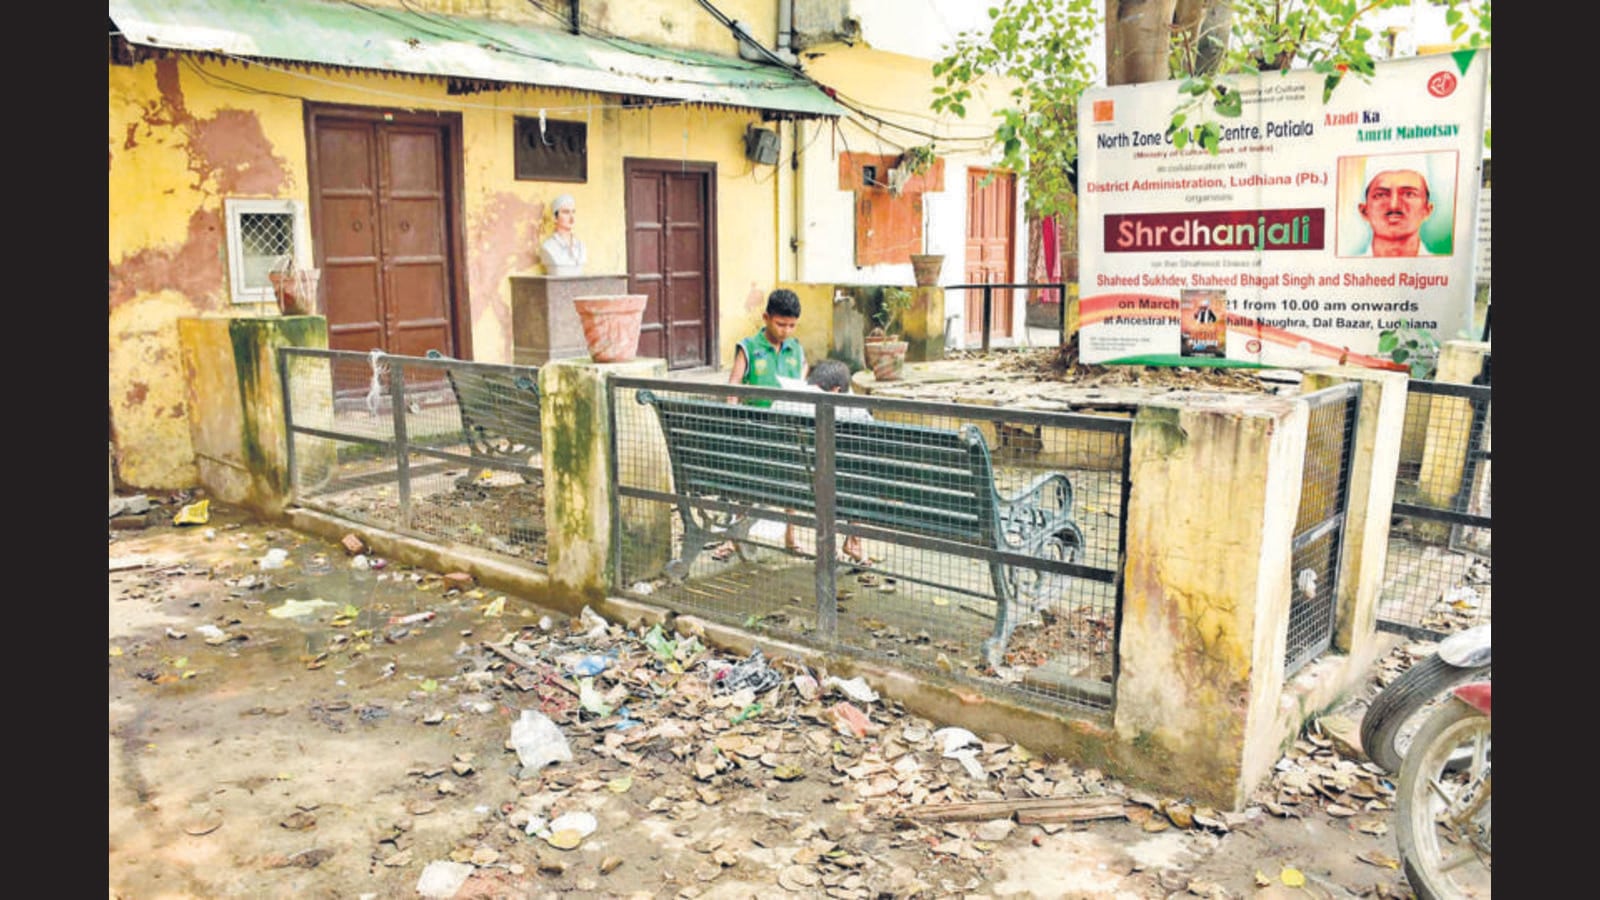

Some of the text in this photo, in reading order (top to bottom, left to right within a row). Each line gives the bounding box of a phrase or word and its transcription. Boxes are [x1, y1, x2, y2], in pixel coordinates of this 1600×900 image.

[1324, 109, 1380, 126] Azadi Ka
[1097, 132, 1130, 149] North
[1132, 130, 1161, 147] Zone
[1267, 119, 1314, 138] Patiala
[1356, 123, 1460, 142] Amrit Mahotsav
[1227, 161, 1247, 170] with
[1087, 171, 1329, 193] District Administration, Ludhiana (Pb.)
[1117, 214, 1310, 251] Shrdhanjali
[1097, 272, 1448, 290] Shaheed Sukhdev, Shaheed Bhagat Singh and Shaheed Rajguru
[1118, 301, 1135, 309] on
[1138, 299, 1180, 310] March
[1243, 300, 1276, 311] from
[1282, 299, 1319, 311] 10.00
[1324, 302, 1347, 311] am
[1351, 300, 1419, 312] onwards
[1103, 316, 1114, 326] at
[1116, 315, 1165, 326] Ancestral
[1226, 316, 1253, 327] halla
[1256, 316, 1309, 329] Naughra,
[1313, 317, 1333, 328] Dal
[1336, 317, 1374, 330] Bazar,
